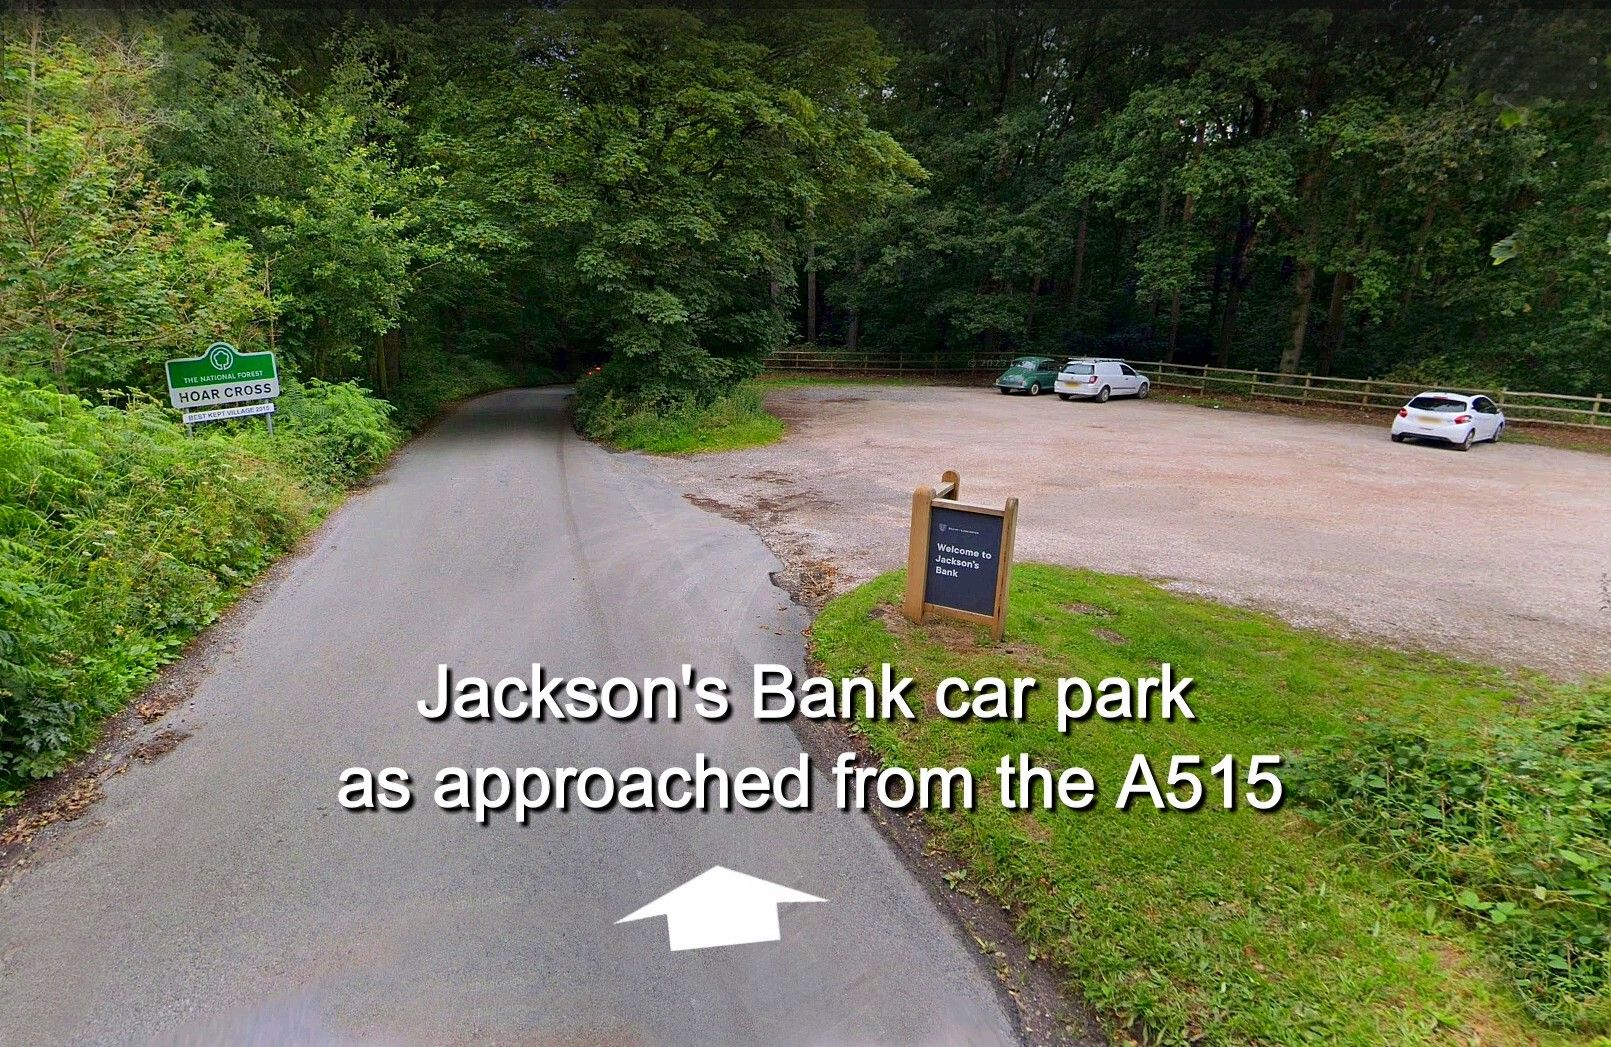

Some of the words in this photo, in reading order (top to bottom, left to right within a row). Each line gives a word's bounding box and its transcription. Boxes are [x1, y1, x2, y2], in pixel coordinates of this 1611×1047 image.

[200, 373, 236, 383] NATIONAL
[237, 370, 263, 379] FOREST
[179, 389, 220, 403] HOAR
[224, 383, 272, 398] CROSS
[188, 413, 206, 421] BEST
[208, 411, 225, 419] KEPT
[227, 408, 254, 416] VILLAGE
[937, 543, 979, 557] Welcome
[981, 551, 992, 560] to
[935, 555, 980, 569] Jackson's
[935, 566, 959, 578] Bank
